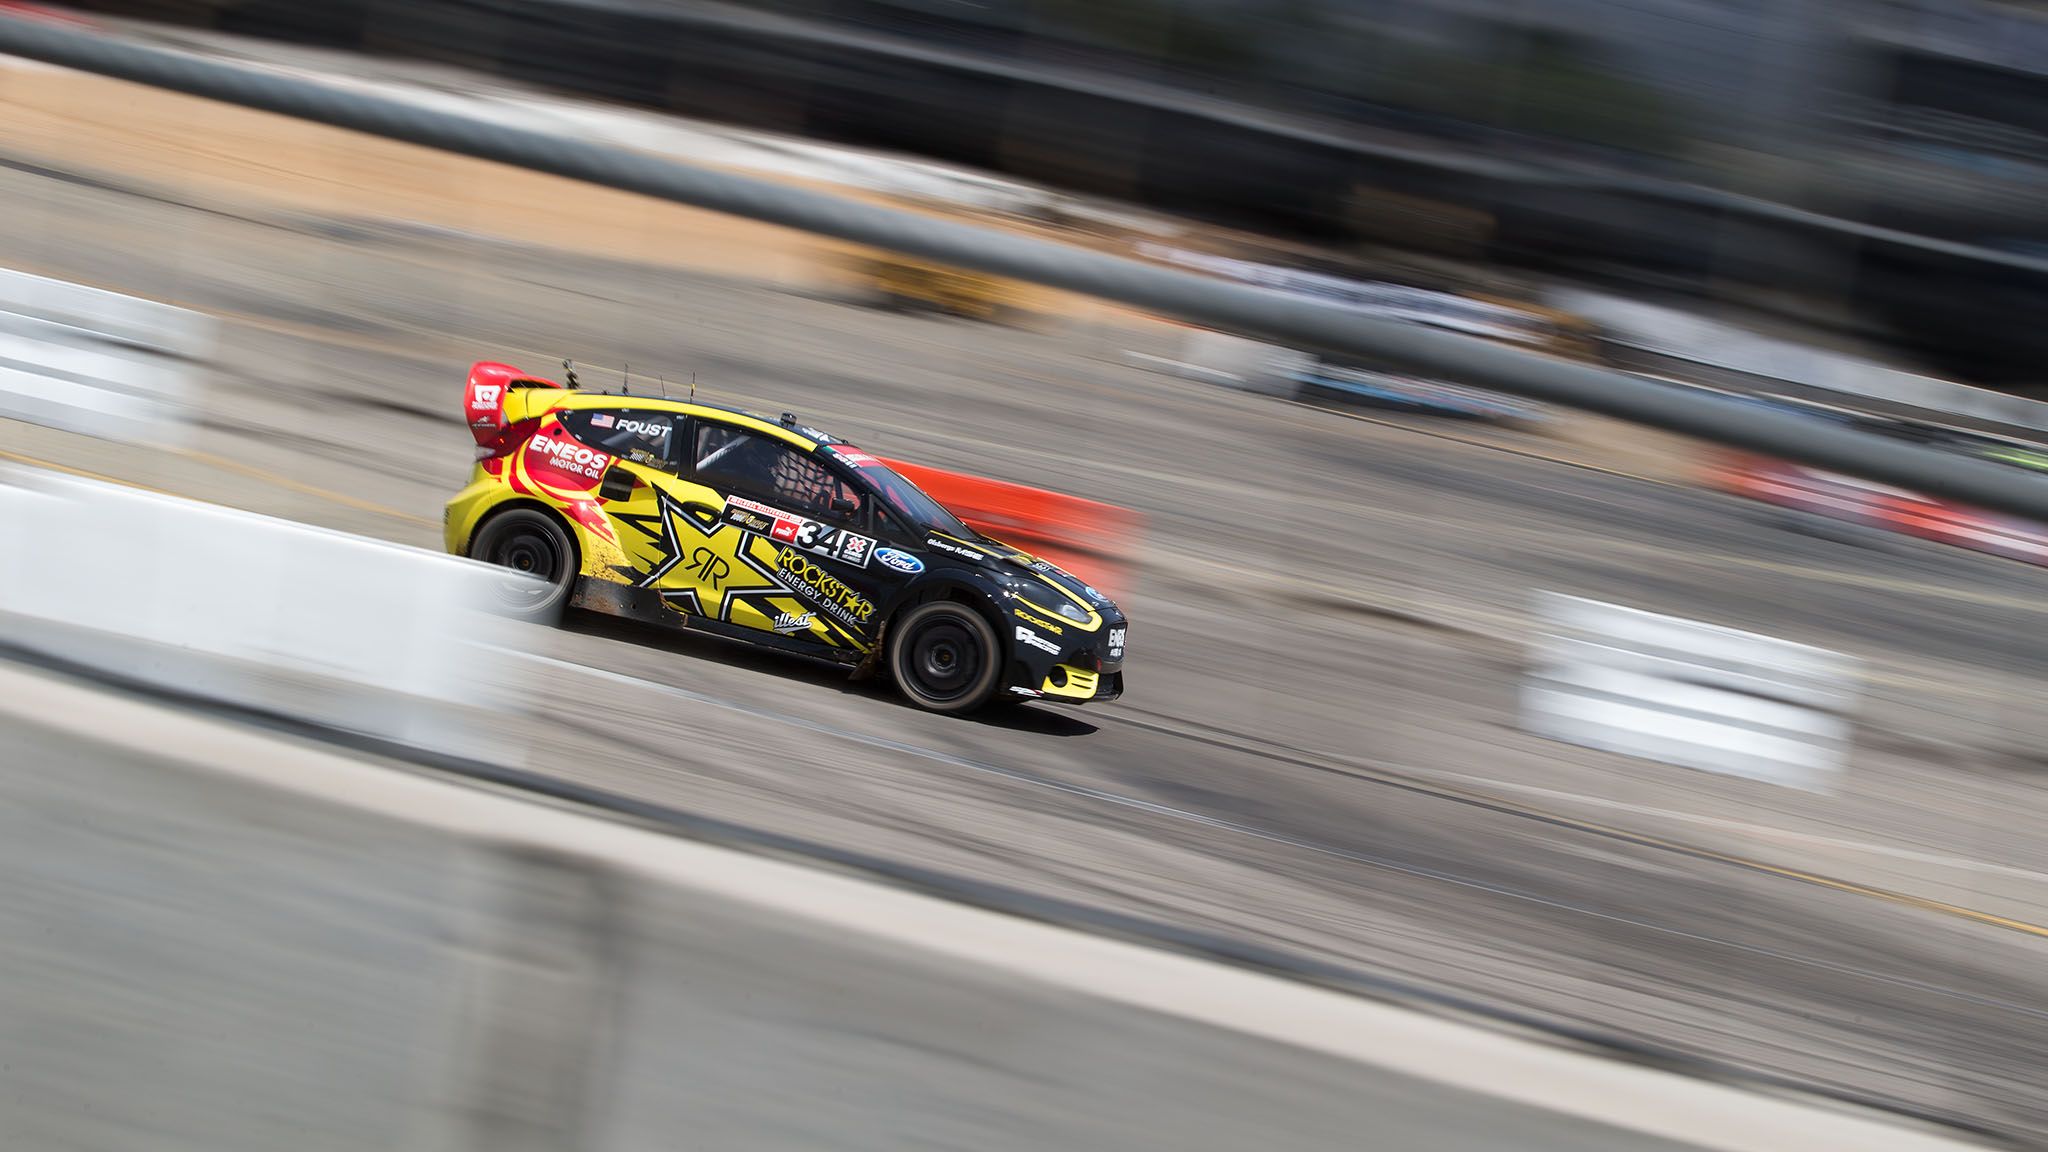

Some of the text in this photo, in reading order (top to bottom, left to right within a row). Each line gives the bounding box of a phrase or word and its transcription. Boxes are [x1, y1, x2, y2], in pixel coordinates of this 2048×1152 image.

[616, 419, 672, 437] FOUST
[529, 434, 608, 469] ENEOS
[549, 456, 600, 480] MOTOR OIL
[797, 521, 842, 557] 34
[881, 550, 916, 571] Ford
[778, 567, 857, 625] ENERGY DRINK
[774, 611, 817, 634] illest
